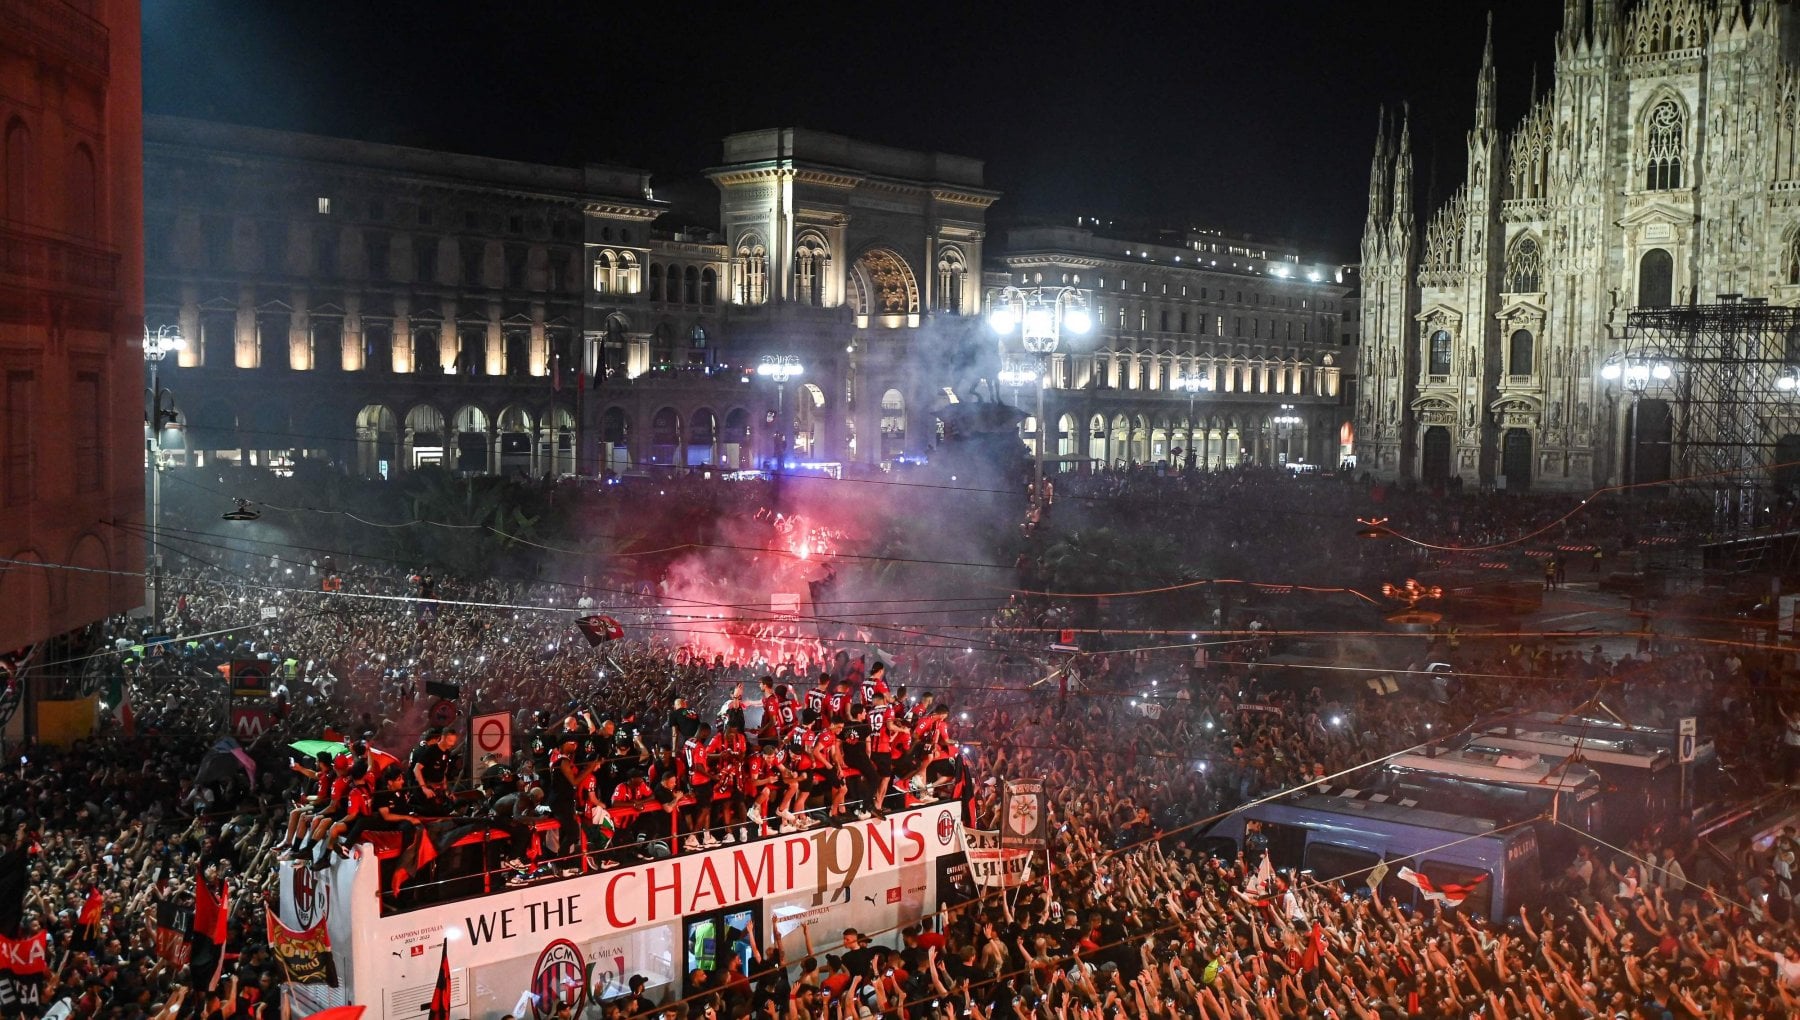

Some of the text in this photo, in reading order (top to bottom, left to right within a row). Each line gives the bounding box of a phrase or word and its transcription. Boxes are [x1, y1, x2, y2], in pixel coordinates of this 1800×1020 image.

[870, 713, 883, 731] 19
[465, 907, 517, 946] WE
[523, 894, 583, 933] THE
[390, 930, 420, 942] CAMPIONI
[544, 947, 574, 968] ACM
[587, 946, 624, 961] AC MILAN
